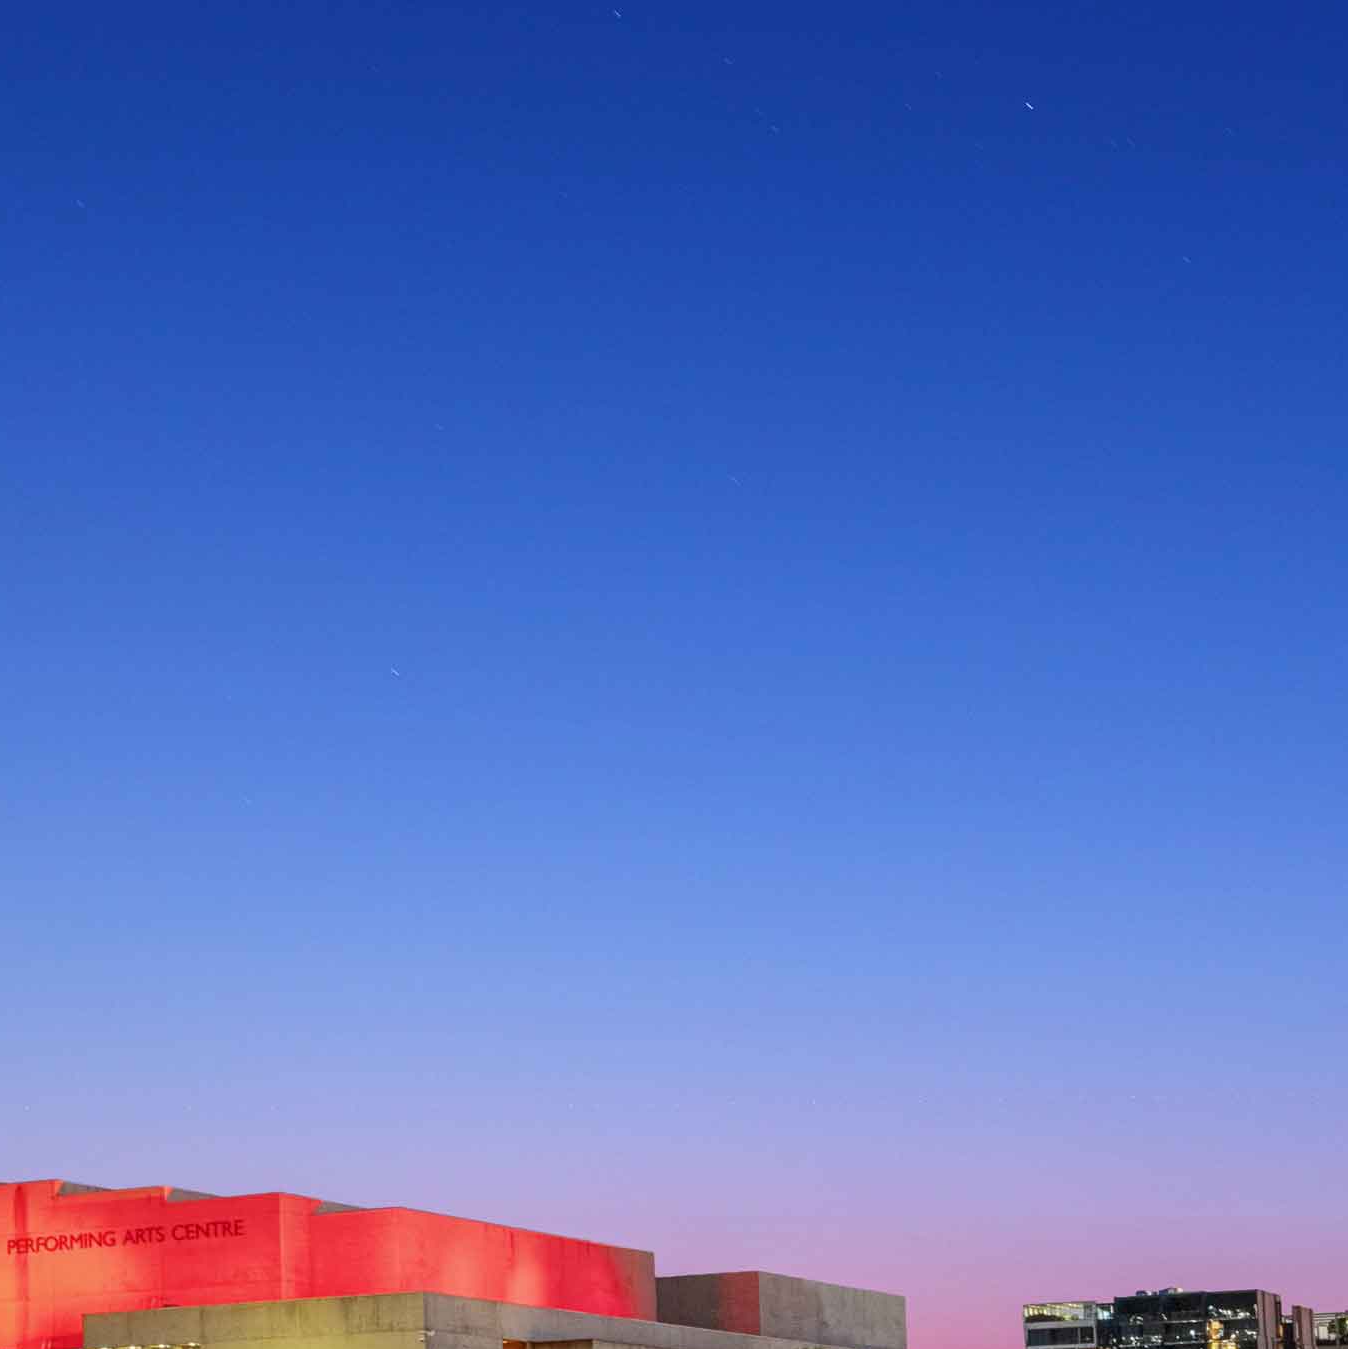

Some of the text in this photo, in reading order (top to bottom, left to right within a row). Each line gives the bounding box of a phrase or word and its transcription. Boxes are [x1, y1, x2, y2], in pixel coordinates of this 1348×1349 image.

[6, 1219, 246, 1255] PERFORMING ARTS CENTRE
